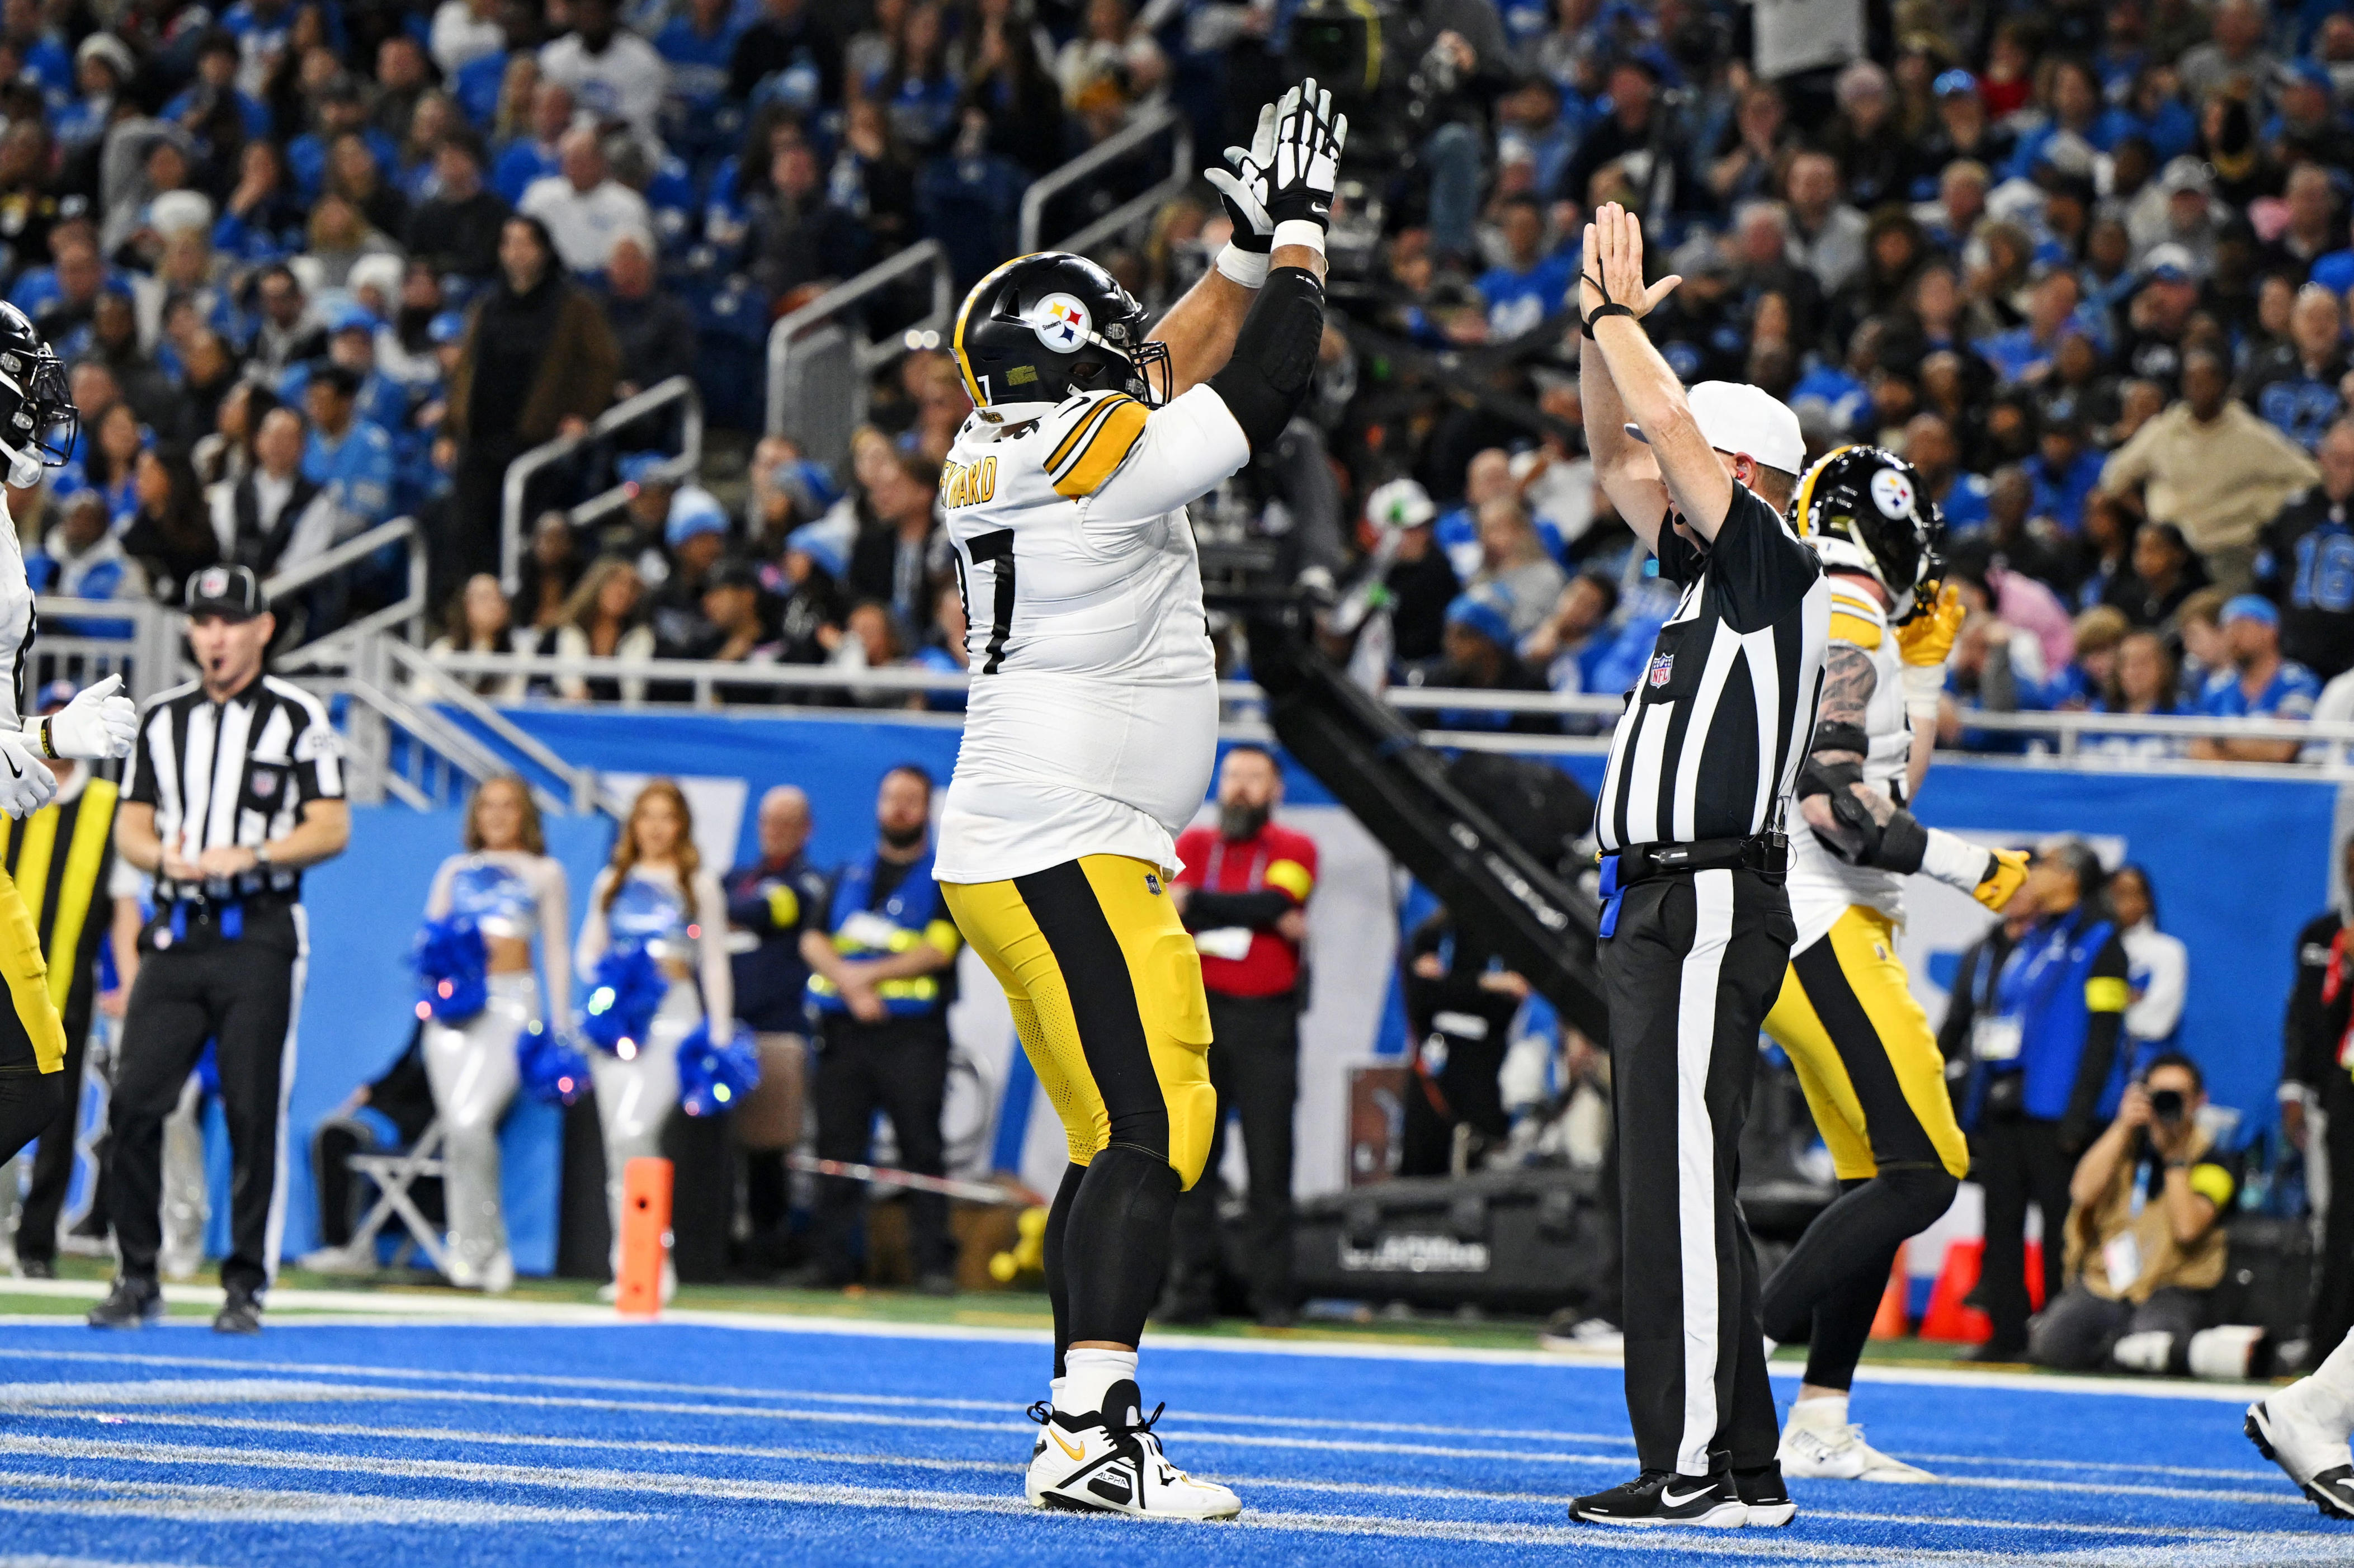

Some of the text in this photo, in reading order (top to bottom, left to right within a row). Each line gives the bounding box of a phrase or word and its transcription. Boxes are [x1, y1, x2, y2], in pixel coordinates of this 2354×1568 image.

[1042, 320, 1062, 331] Steelers
[939, 456, 997, 509] EYWARD
[950, 528, 1016, 674] 7
[1652, 668, 1667, 683] NFL
[1096, 1472, 1127, 1487] ALPHA
